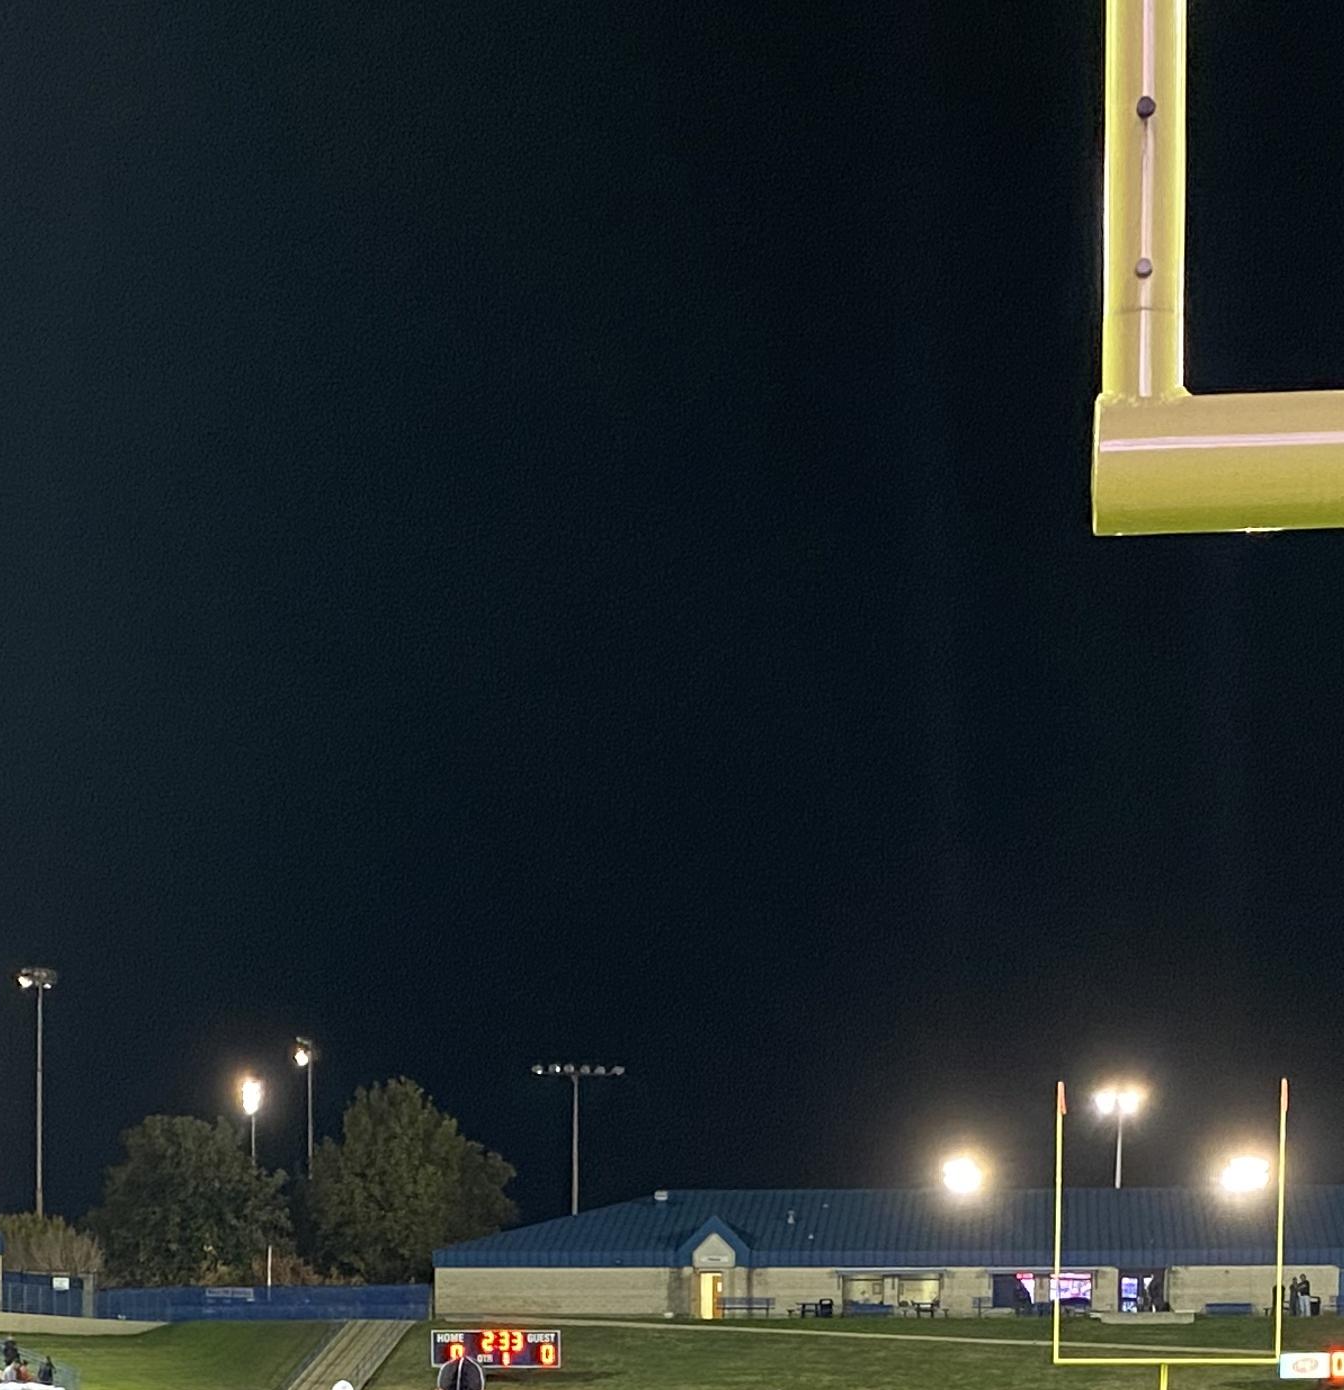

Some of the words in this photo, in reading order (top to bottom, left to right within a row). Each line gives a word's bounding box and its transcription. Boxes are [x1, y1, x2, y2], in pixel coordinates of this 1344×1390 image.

[437, 1333, 464, 1343] HOME
[527, 1333, 556, 1343] GUEST
[539, 1344, 555, 1365] 0
